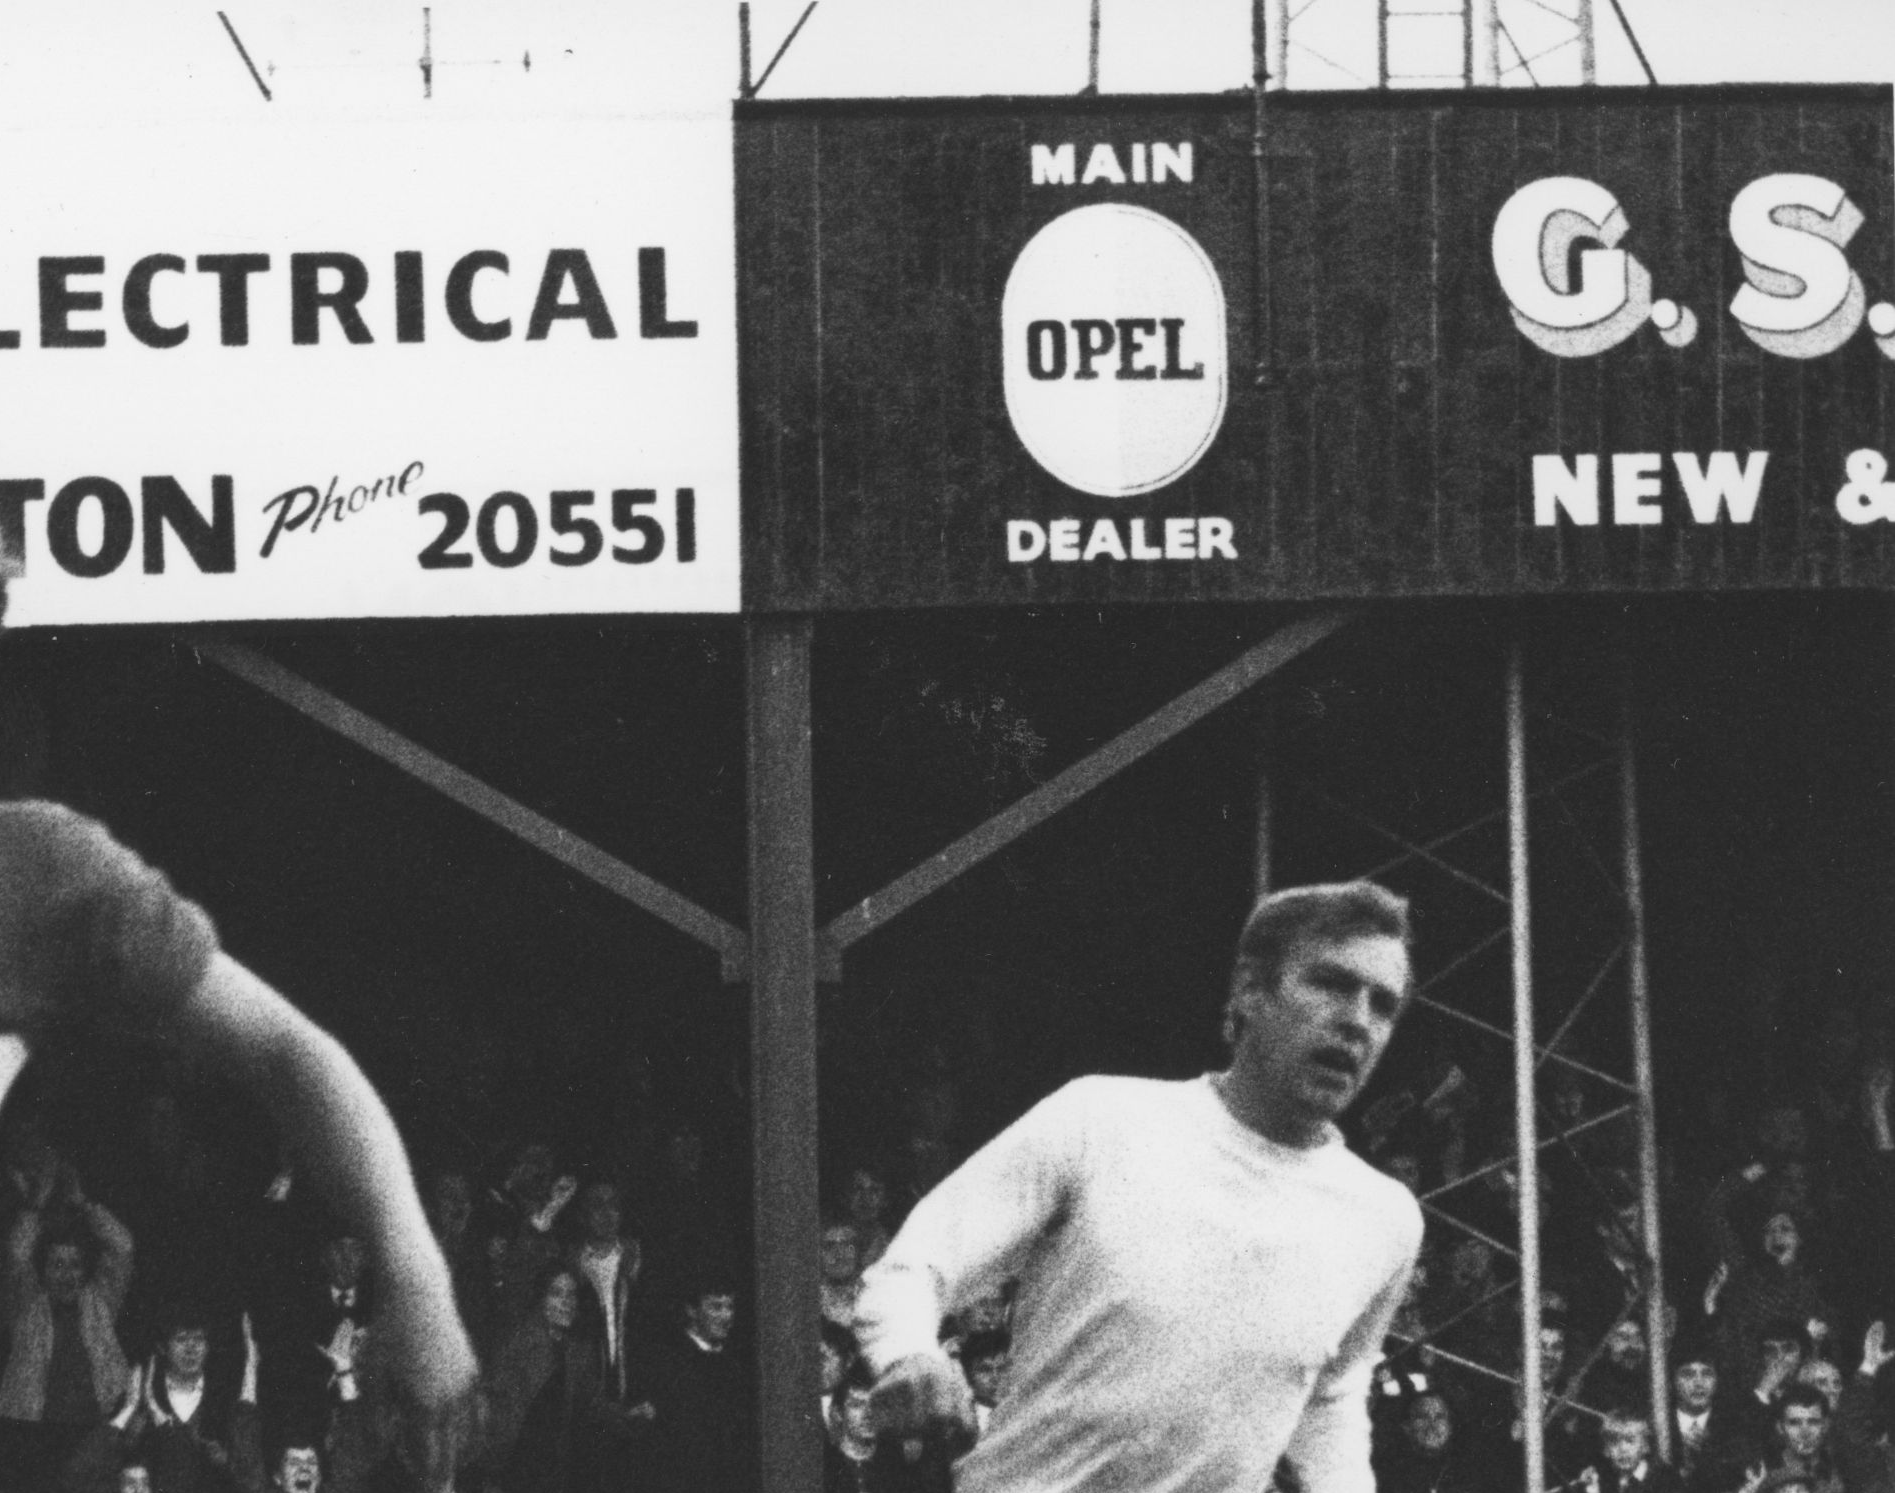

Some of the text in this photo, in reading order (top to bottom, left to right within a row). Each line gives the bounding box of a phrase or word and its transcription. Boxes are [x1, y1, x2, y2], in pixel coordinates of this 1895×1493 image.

[1030, 142, 1193, 185] MAIN
[1026, 317, 1205, 381] OPEL
[259, 460, 425, 559] Phone
[417, 486, 697, 569] 20551
[1531, 448, 1895, 527] NEW &
[1006, 517, 1238, 563] DEALER
